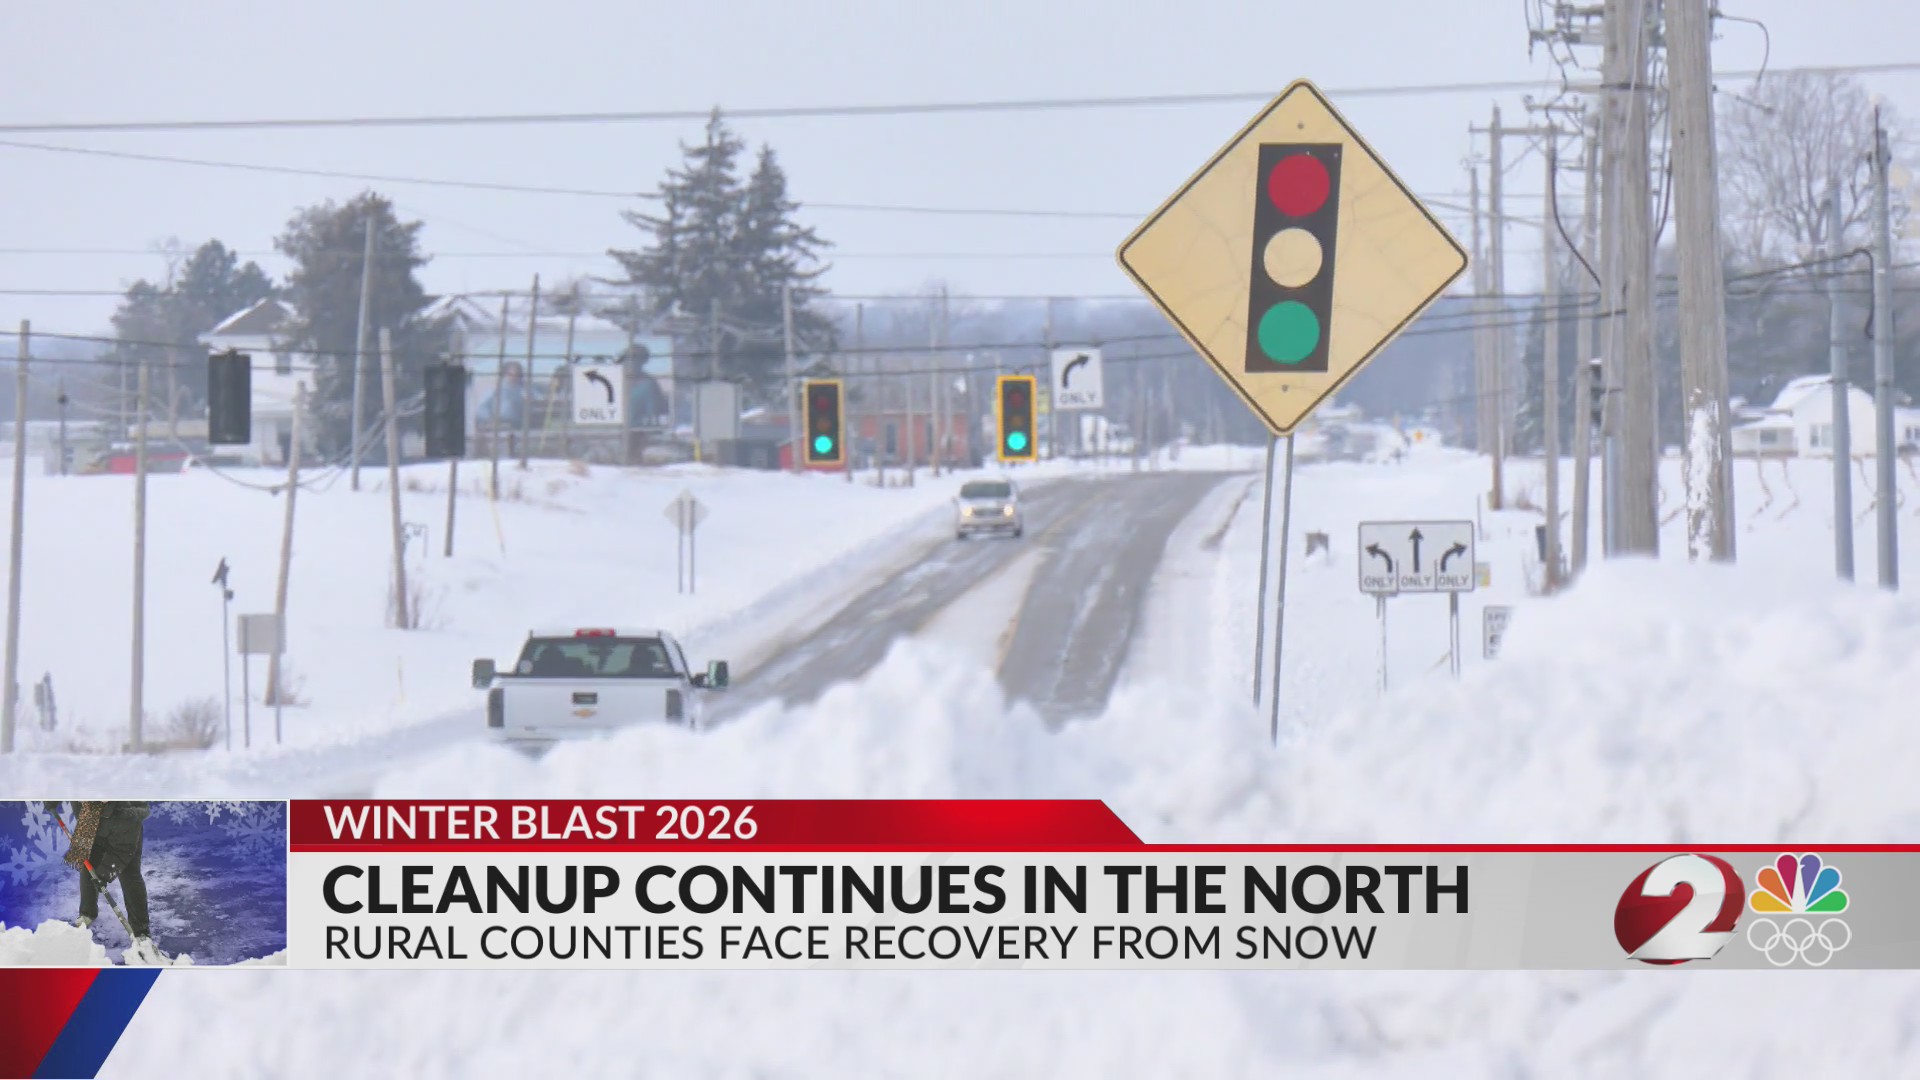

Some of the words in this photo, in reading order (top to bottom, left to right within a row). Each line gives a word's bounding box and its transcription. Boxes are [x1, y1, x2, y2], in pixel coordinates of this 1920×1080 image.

[1059, 391, 1097, 405] ONLY
[579, 408, 617, 421] ONLY
[1363, 575, 1395, 587] ONLY
[1400, 575, 1432, 587] ONLY
[1439, 574, 1470, 586] ONLY
